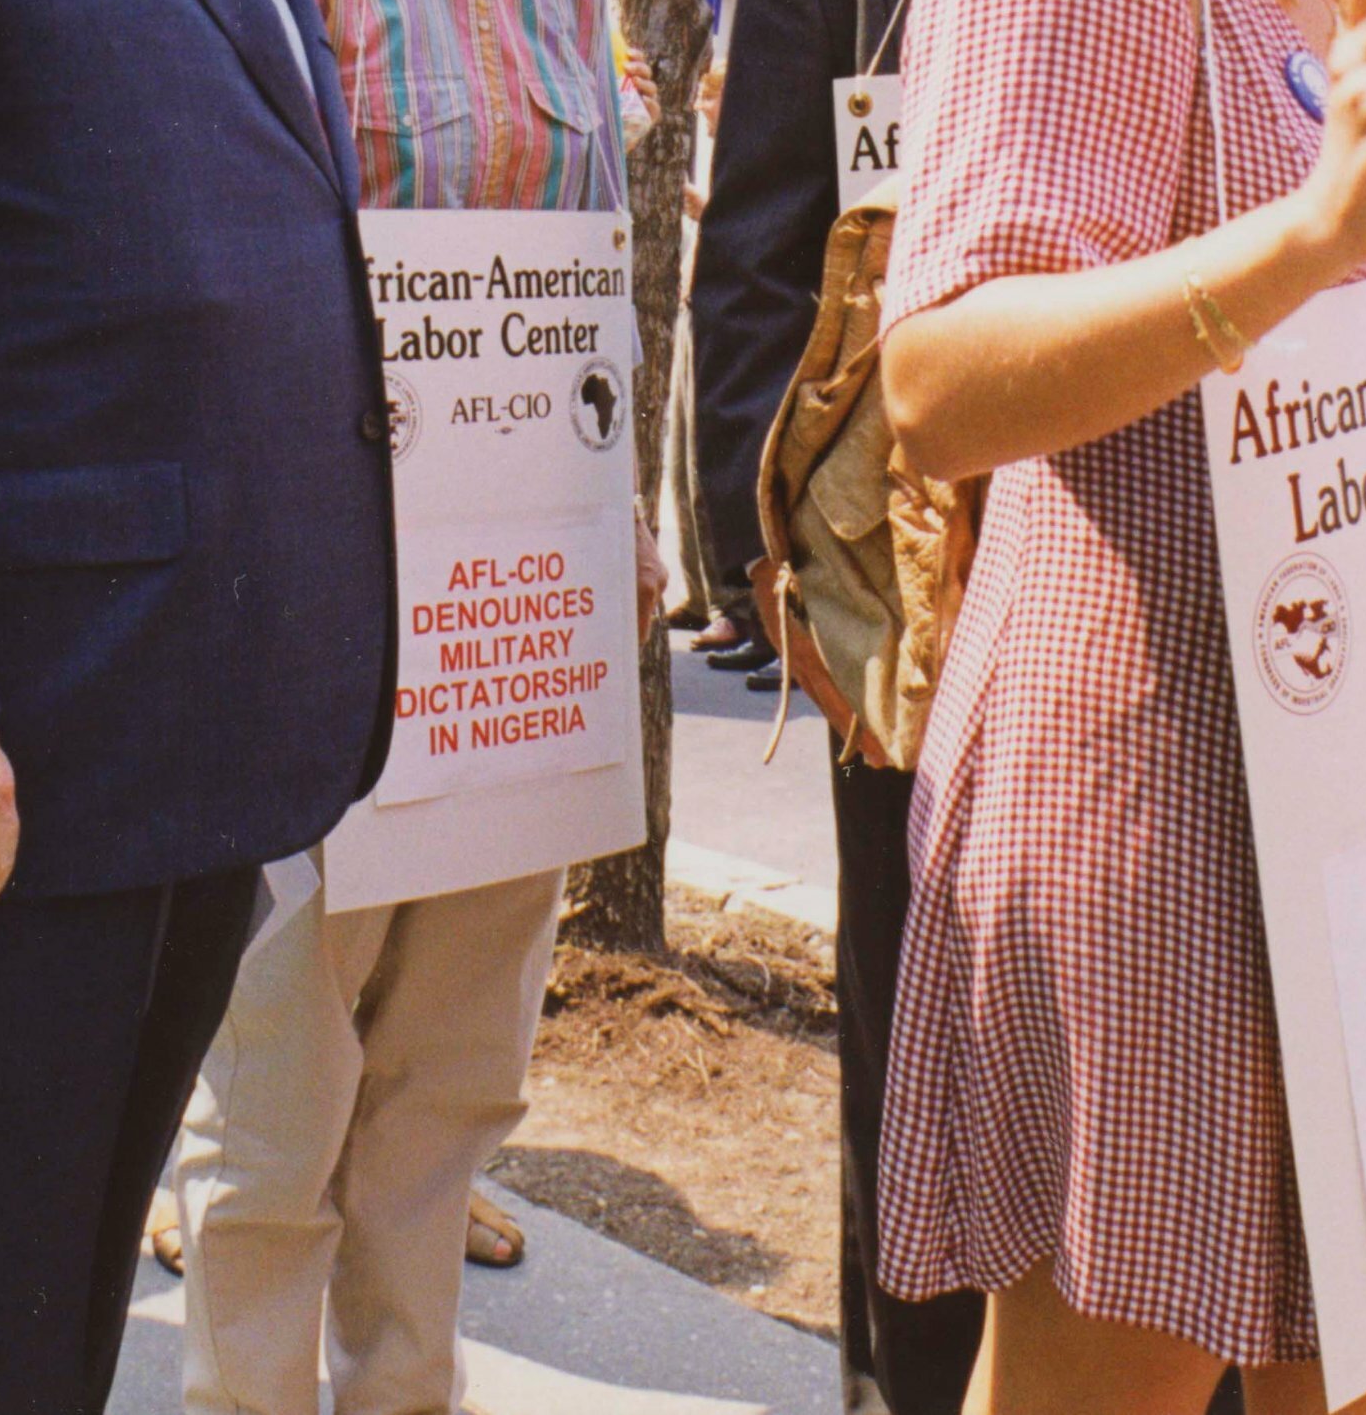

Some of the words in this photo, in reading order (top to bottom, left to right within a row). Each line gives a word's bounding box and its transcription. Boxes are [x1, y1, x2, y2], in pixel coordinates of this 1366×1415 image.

[374, 314, 483, 362] Labor
[500, 311, 600, 358] Center
[451, 392, 552, 425] AFL-CIO
[448, 552, 565, 592] AFL-CIO
[412, 586, 595, 635] DENOUNCES
[440, 627, 574, 673] MILITARY
[396, 660, 608, 719] DICTATORSHIP
[430, 723, 459, 756] IN
[471, 704, 586, 750] NIGERIA
